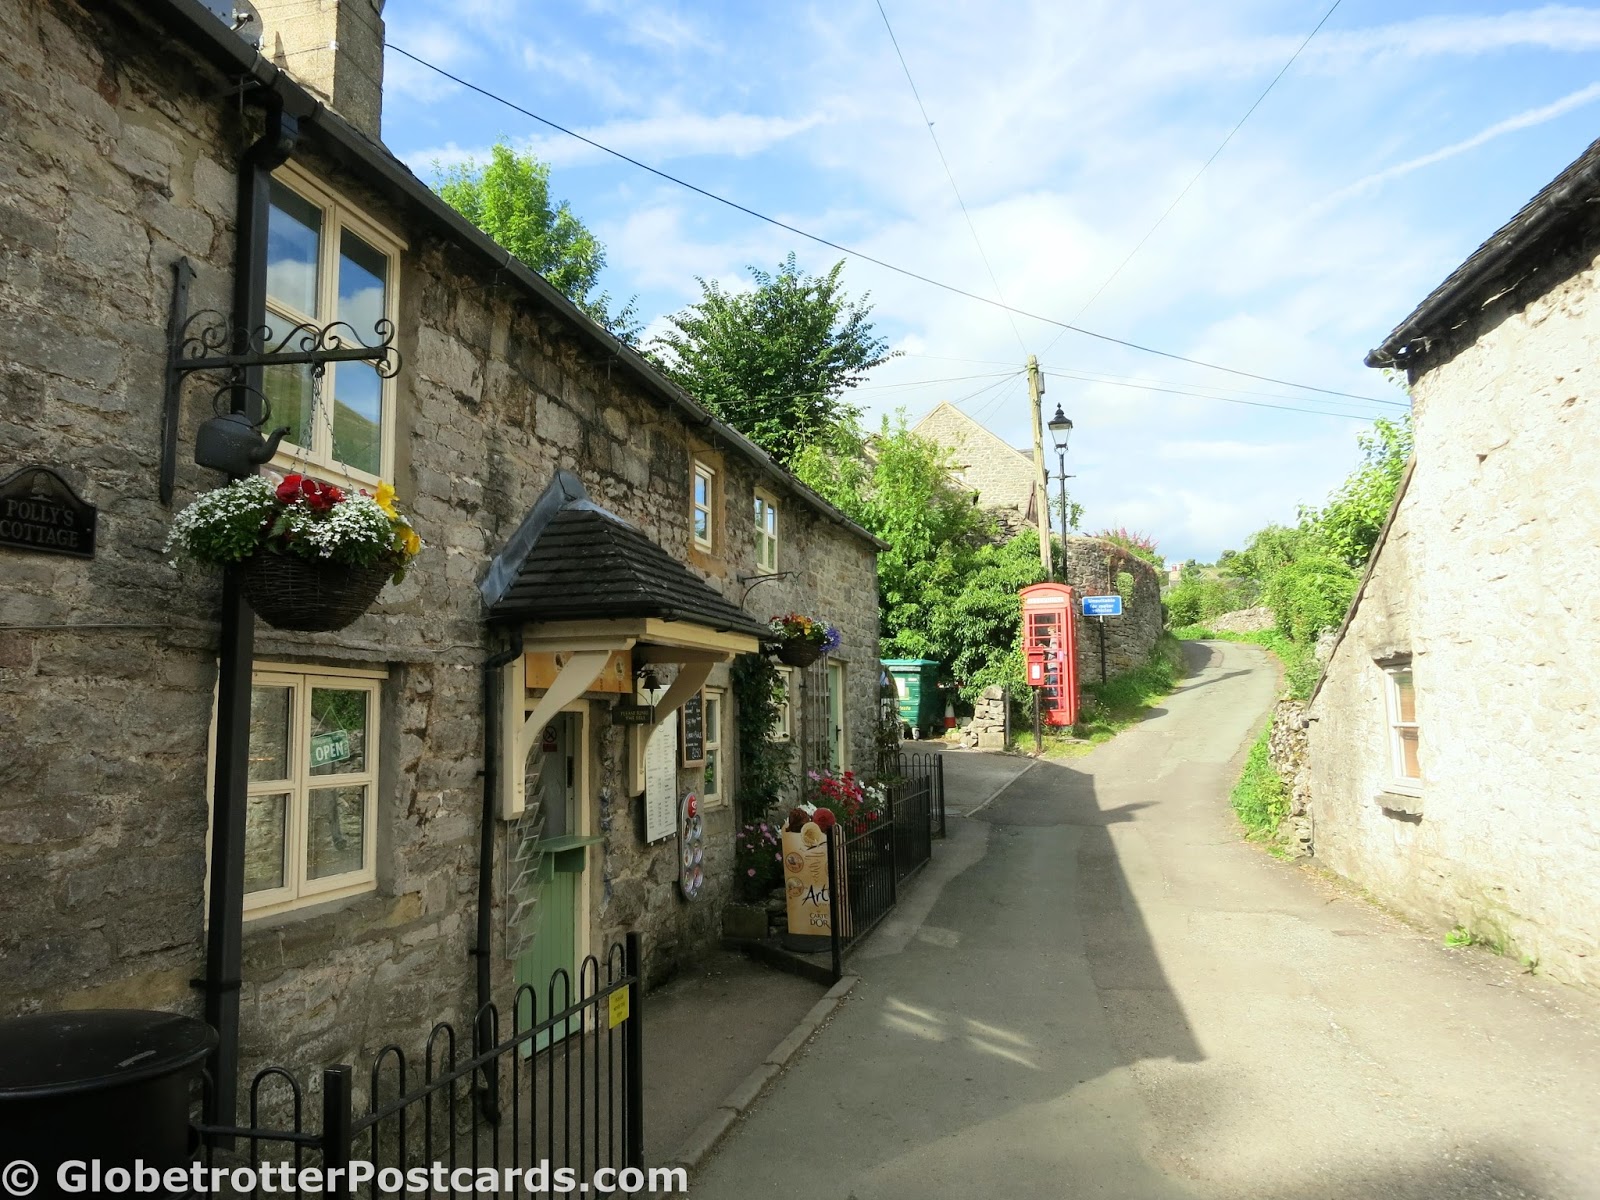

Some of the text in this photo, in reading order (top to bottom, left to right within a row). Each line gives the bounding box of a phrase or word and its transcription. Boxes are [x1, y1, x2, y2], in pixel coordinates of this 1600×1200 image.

[6, 500, 74, 527] POLLY'S
[0, 519, 79, 548] COTTAGE
[315, 741, 344, 761] OPEN
